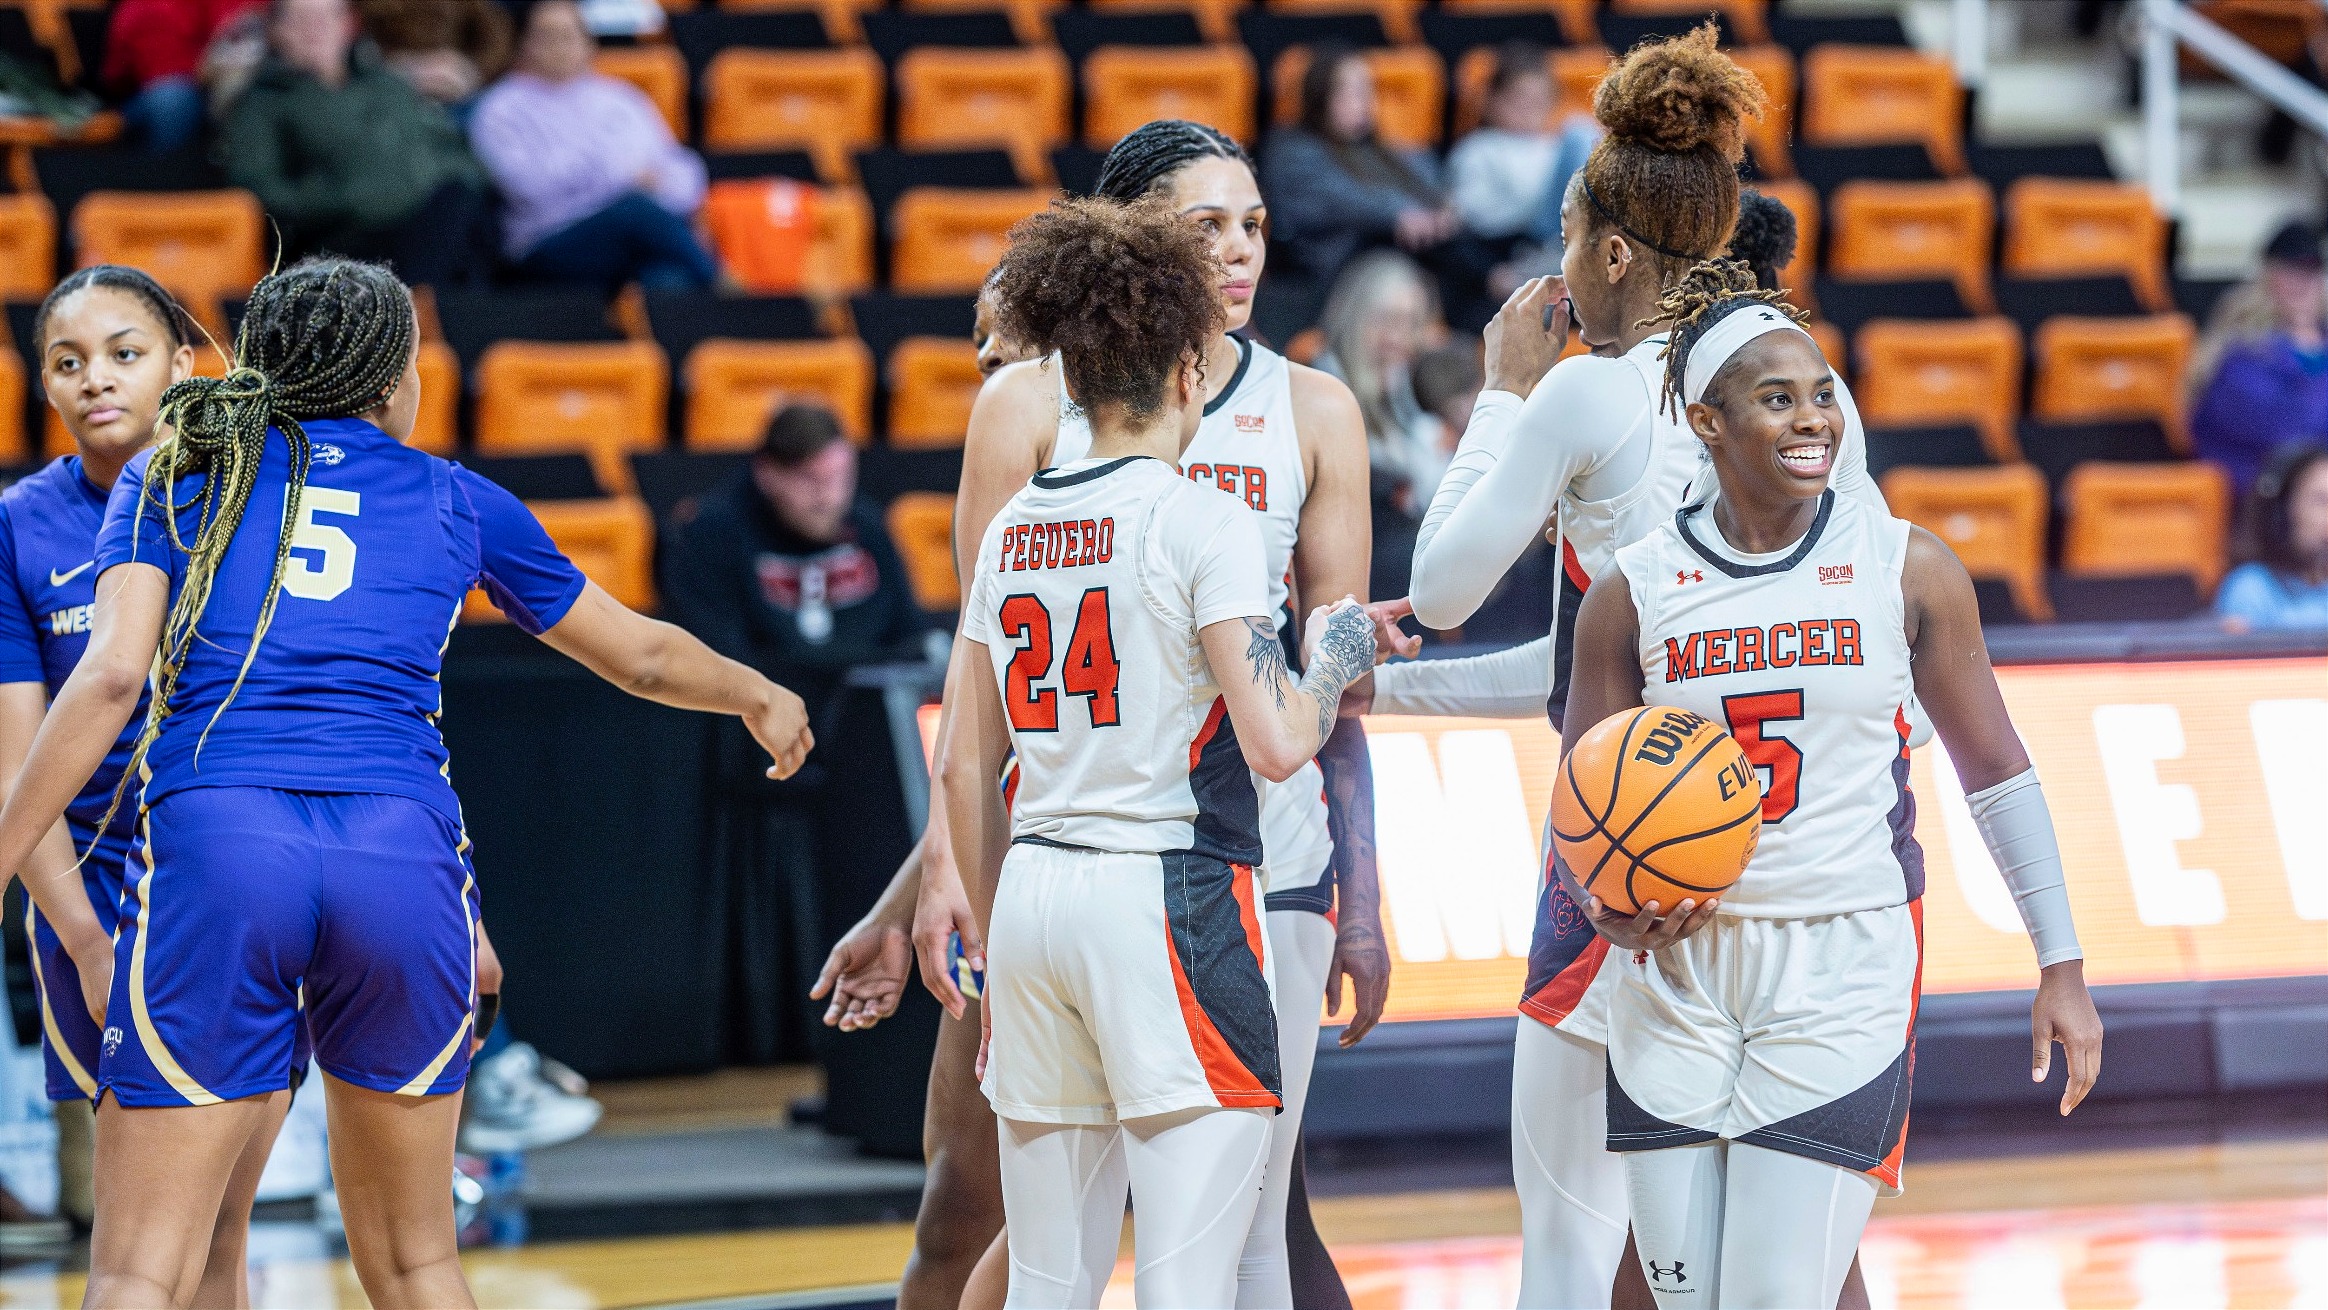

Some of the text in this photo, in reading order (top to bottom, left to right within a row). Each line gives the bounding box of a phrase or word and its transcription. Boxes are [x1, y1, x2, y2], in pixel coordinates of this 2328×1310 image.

[283, 481, 361, 602] 5
[998, 516, 1115, 573] PEGUERO
[50, 602, 96, 637] WES
[1664, 617, 1864, 684] MERCER
[998, 585, 1121, 733] 24
[1634, 711, 1711, 766] Wils
[1721, 687, 1805, 825] 5
